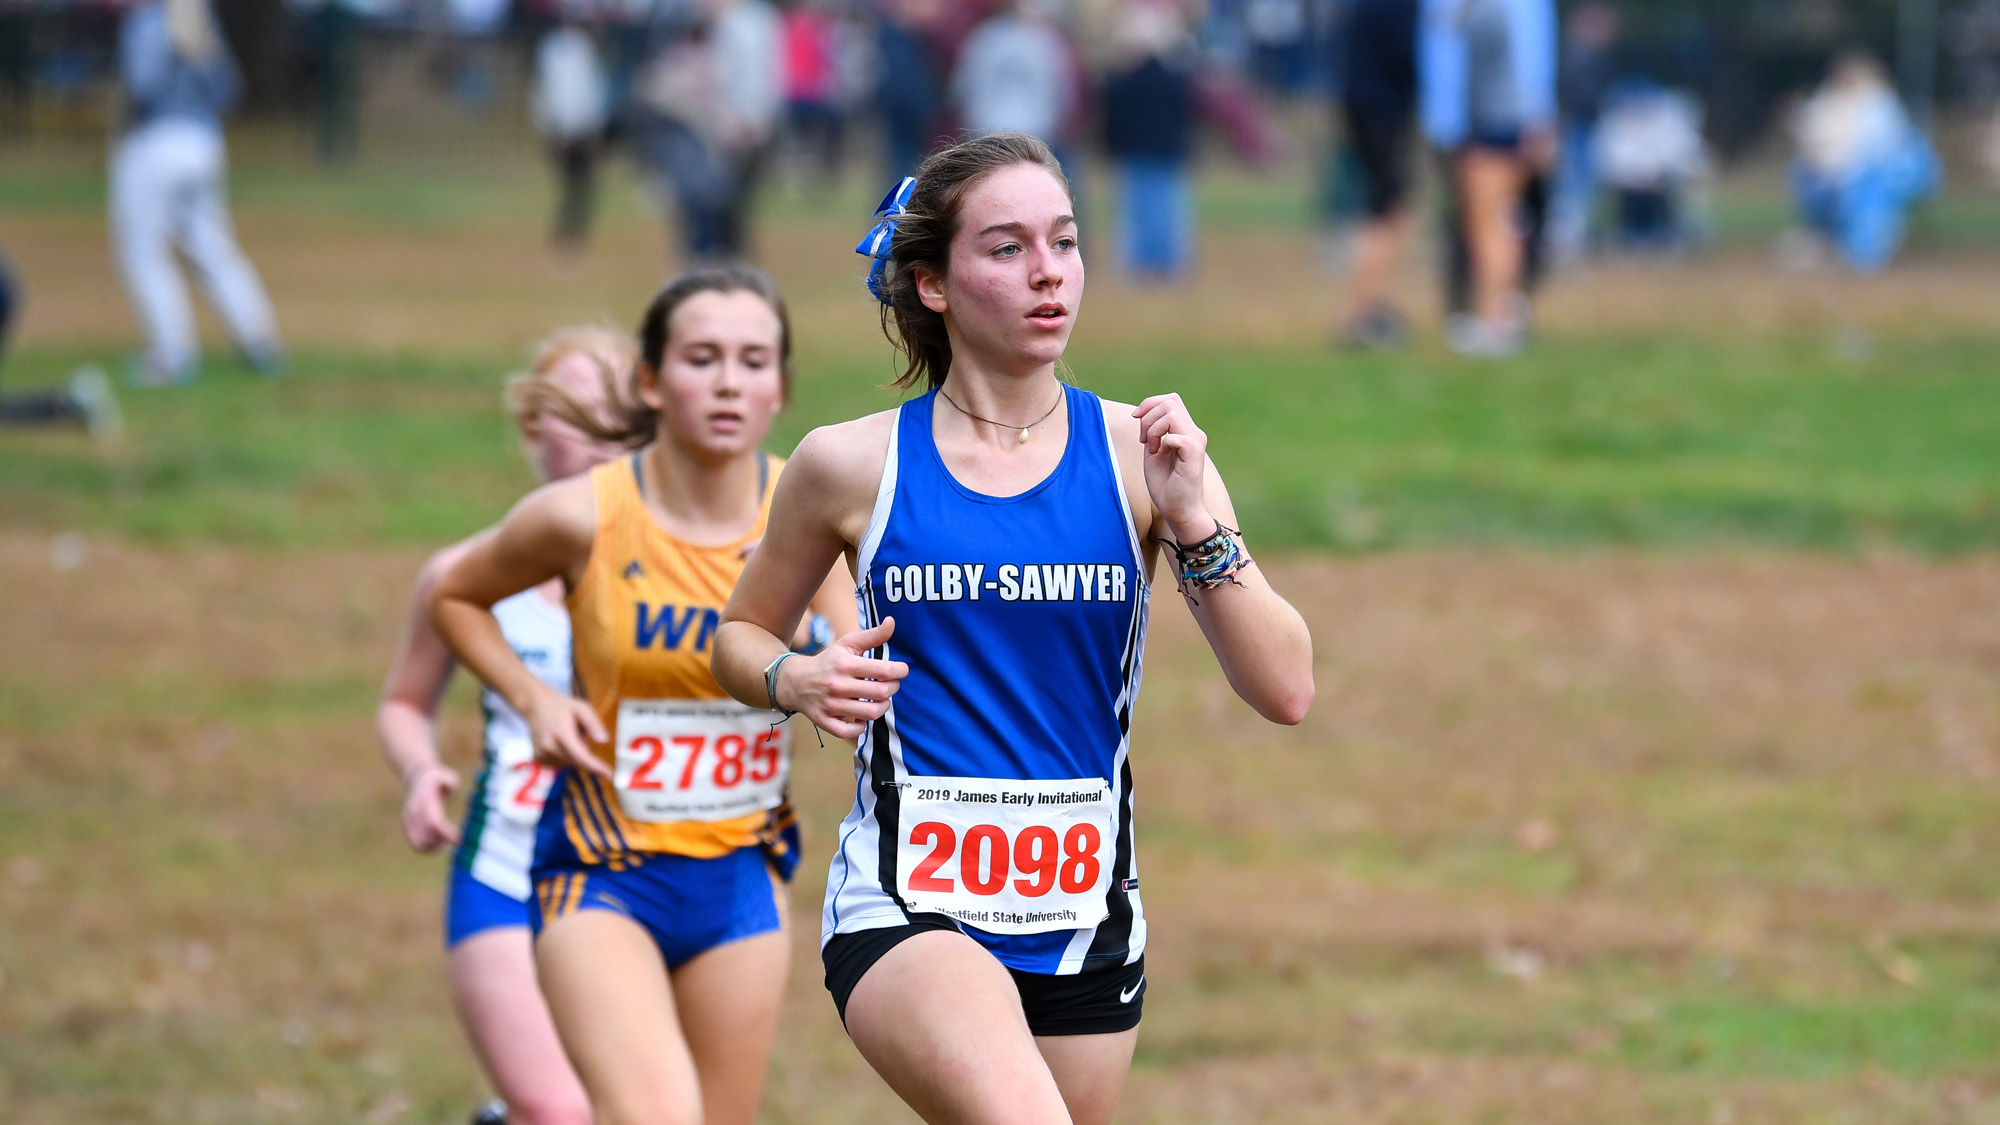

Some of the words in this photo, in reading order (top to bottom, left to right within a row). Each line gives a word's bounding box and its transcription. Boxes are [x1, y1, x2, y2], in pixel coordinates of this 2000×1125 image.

[884, 563, 1127, 603] COLBY-SAWYER
[628, 730, 781, 790] 2785
[917, 788, 951, 801] 2019
[954, 790, 998, 804] James
[1001, 791, 1035, 807] Early
[1037, 789, 1102, 805] Invitational
[907, 821, 1101, 898] 2098
[992, 911, 1023, 924] State
[1025, 909, 1077, 923] University
